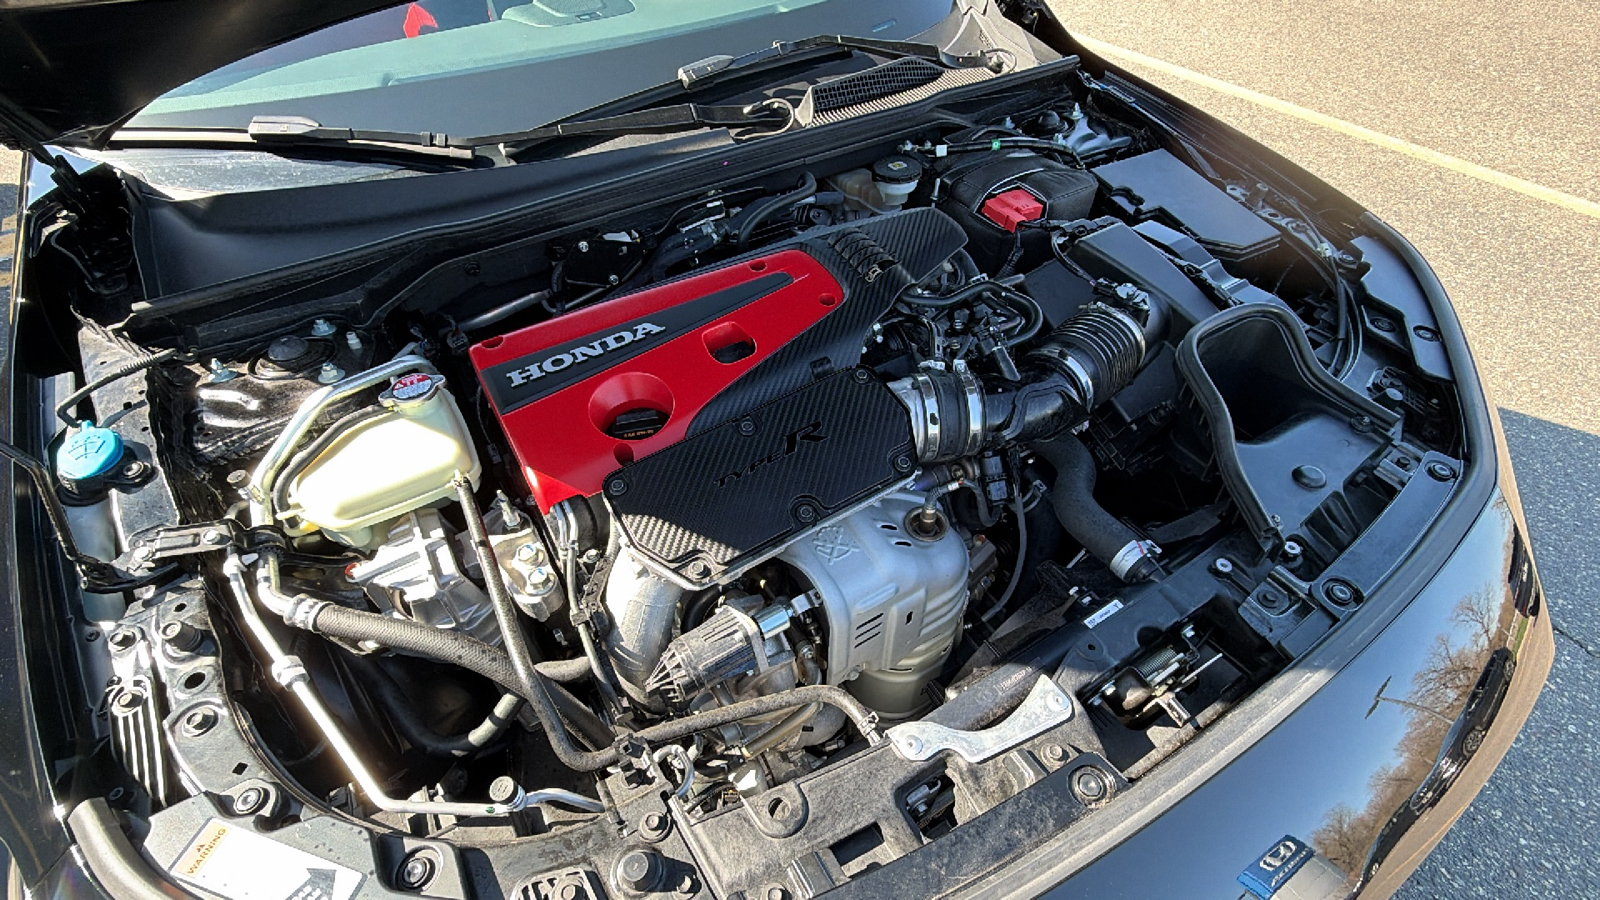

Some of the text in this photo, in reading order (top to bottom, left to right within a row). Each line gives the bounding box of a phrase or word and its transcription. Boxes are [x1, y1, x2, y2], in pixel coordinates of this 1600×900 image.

[506, 322, 666, 388] HONDA
[713, 420, 830, 488] TYPE R
[186, 828, 227, 874] WARNING
